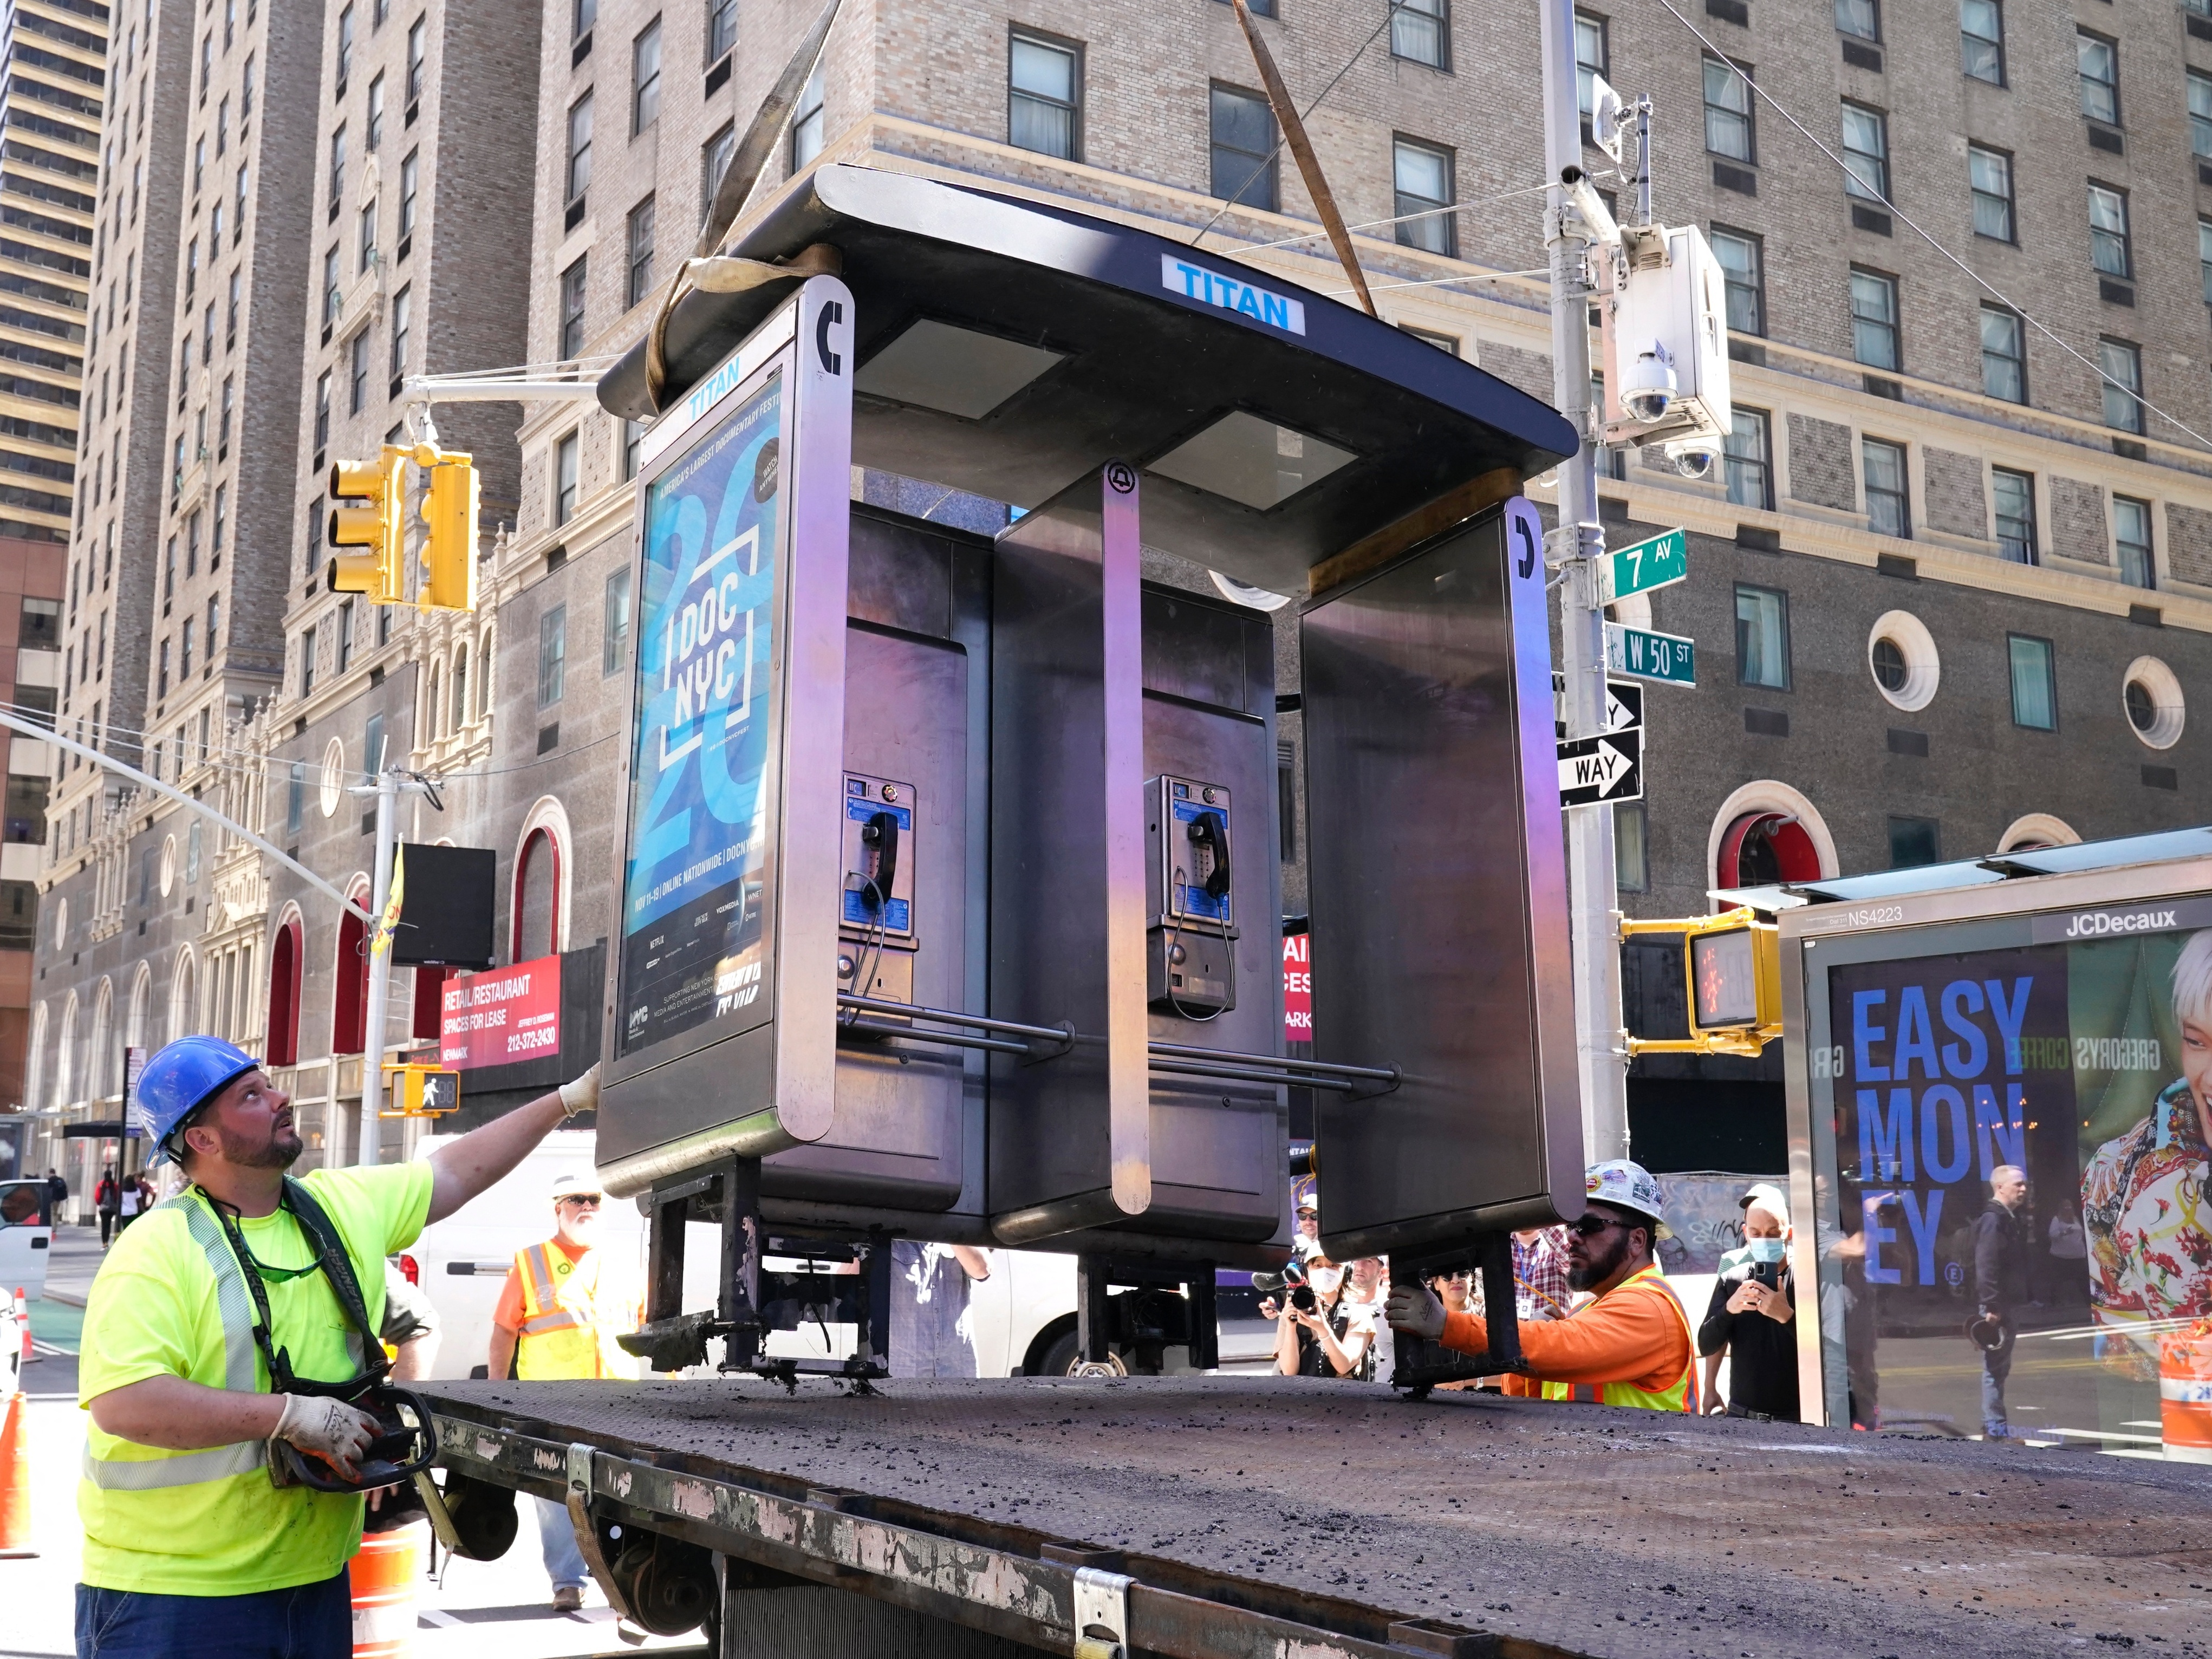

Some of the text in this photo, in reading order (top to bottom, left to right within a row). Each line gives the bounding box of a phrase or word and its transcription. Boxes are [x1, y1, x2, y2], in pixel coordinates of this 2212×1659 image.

[1177, 263, 1289, 330] TITAN
[689, 356, 740, 421] TITAN
[660, 467, 689, 500] AMERICA'S
[690, 445, 715, 476] LARGEST
[715, 407, 759, 454] DOCUMENTARY
[763, 455, 778, 478] WATCH
[1626, 538, 1671, 588] 7 AV
[679, 572, 739, 665] DOC
[1630, 634, 1689, 676] W 50 ST
[674, 638, 735, 729] NYC
[1576, 754, 1617, 785] WAY
[635, 893, 646, 913] NOV
[662, 874, 682, 896] ONLINE
[683, 850, 722, 887] NATIONWIDE
[747, 889, 762, 901] WNET
[1849, 906, 1902, 927] NS4223
[2066, 910, 2177, 936] JCDecaux
[650, 935, 665, 951] NETFLIX
[1283, 937, 1310, 962] AI
[444, 974, 531, 1012] RETAIL/RESTAURANT
[654, 1007, 667, 1018] MEDIA
[667, 1003, 676, 1012] AND
[676, 986, 714, 1008] ENTERTAINMENT
[663, 986, 691, 1004] SUPPORTING
[691, 983, 701, 993] NEW
[701, 977, 714, 988] YORK
[444, 1009, 506, 1035] SPACES FOR LEASE
[629, 1005, 648, 1029] NYC
[1852, 977, 2034, 1082] EASY
[443, 1046, 468, 1062] NEWMARK
[507, 1026, 555, 1053] 212-372-2430
[1856, 1082, 2027, 1185] MON
[1860, 1189, 1945, 1286] EY
